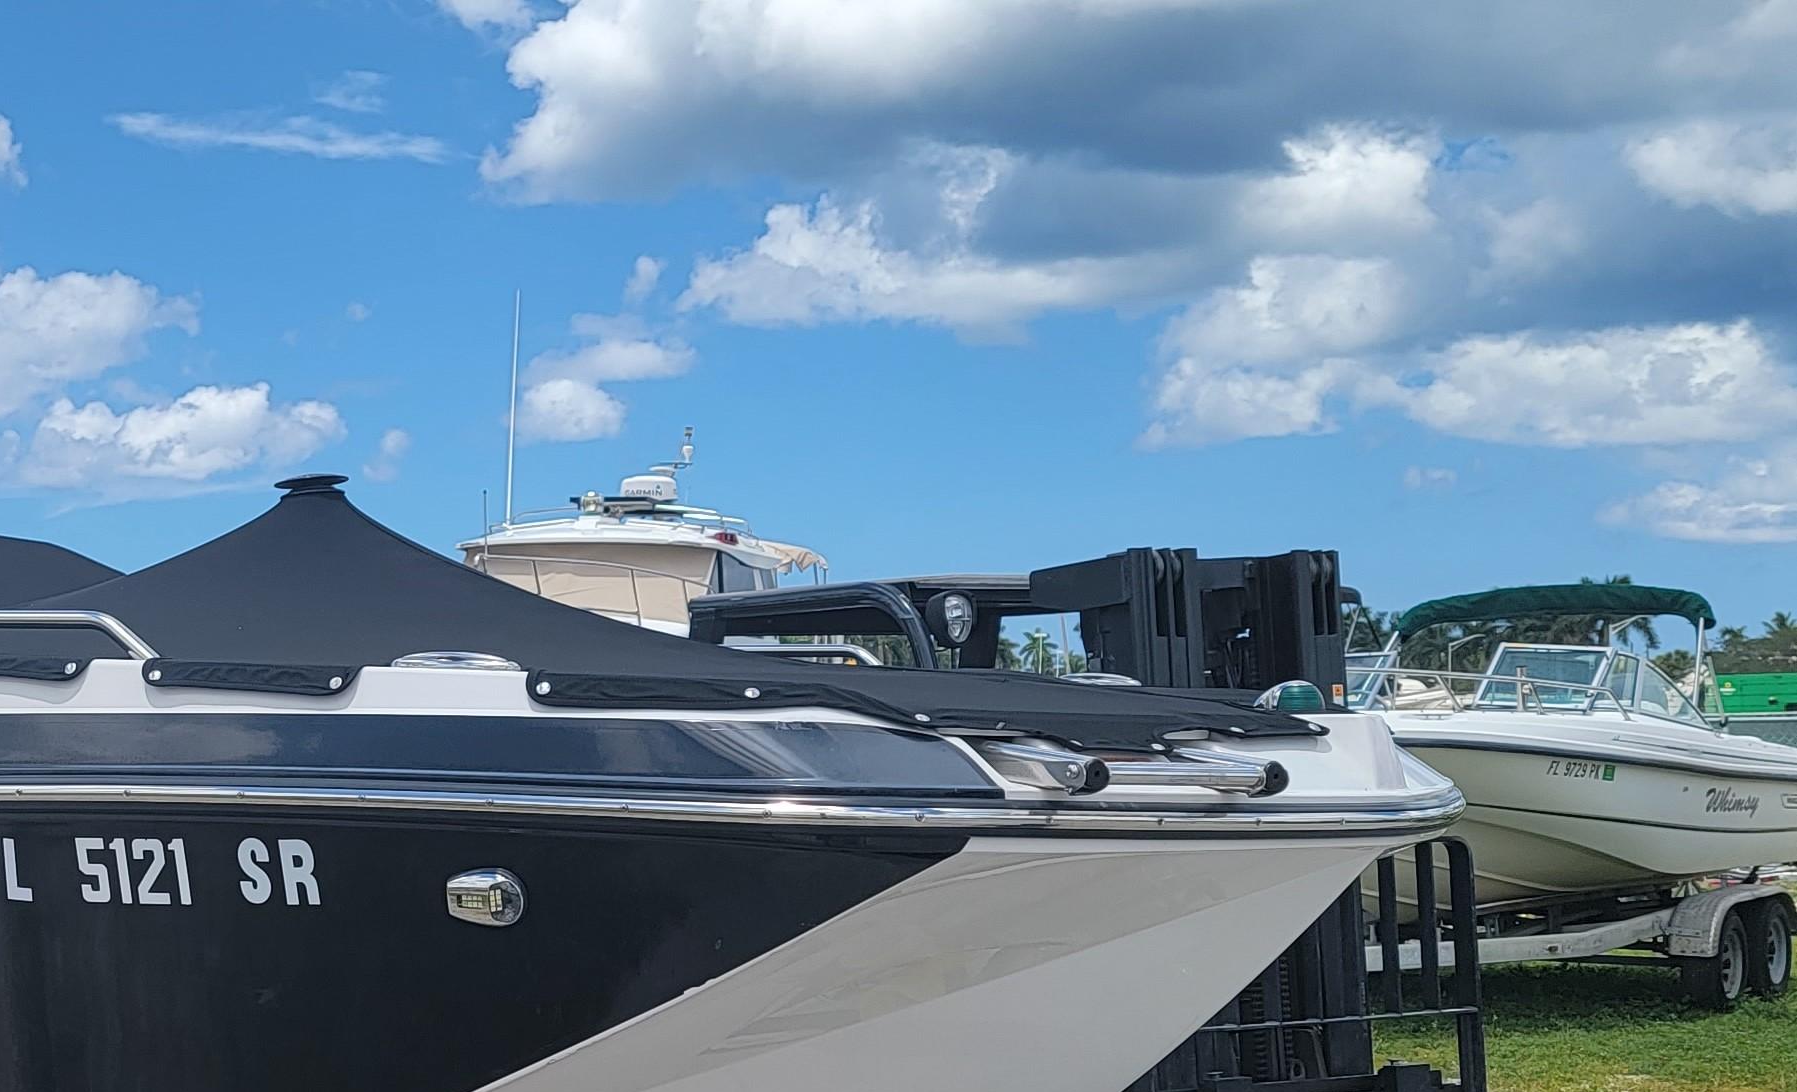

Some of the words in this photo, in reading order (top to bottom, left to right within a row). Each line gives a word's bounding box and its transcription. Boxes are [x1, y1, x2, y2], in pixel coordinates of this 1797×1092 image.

[625, 488, 663, 497] GARMIN
[1546, 760, 1560, 775] FL
[1564, 762, 1588, 778] 9729
[1589, 763, 1601, 779] PK
[1706, 786, 1760, 819] Whimsy
[74, 837, 192, 906] 5121
[237, 837, 321, 906] SR
